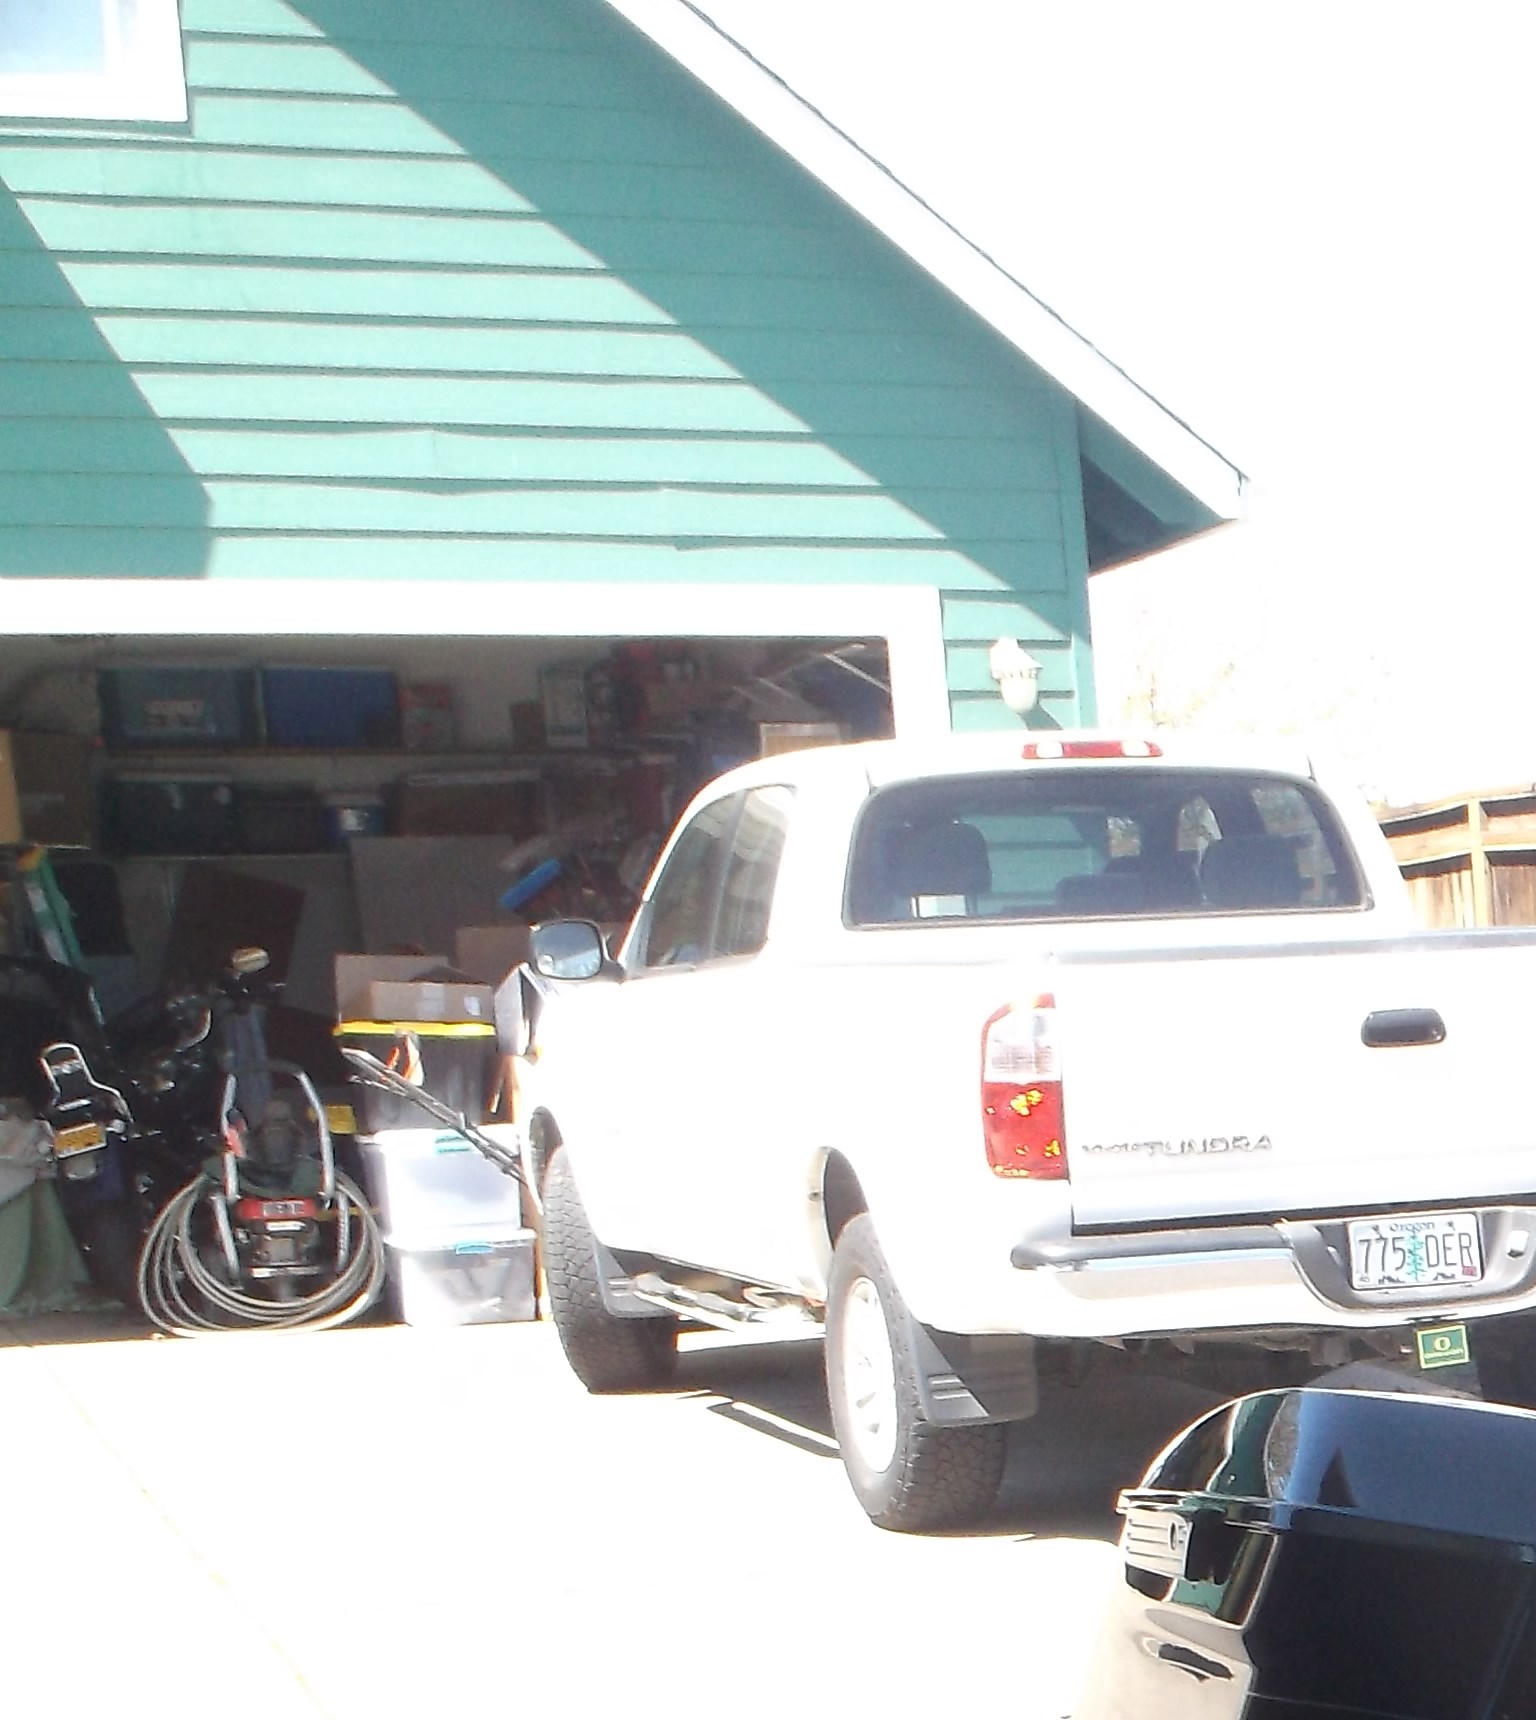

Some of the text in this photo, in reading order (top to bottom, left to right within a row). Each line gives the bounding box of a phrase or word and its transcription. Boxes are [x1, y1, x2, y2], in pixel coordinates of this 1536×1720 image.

[1389, 1221, 1435, 1233] Oregon
[1358, 1232, 1474, 1274] 775 DER
